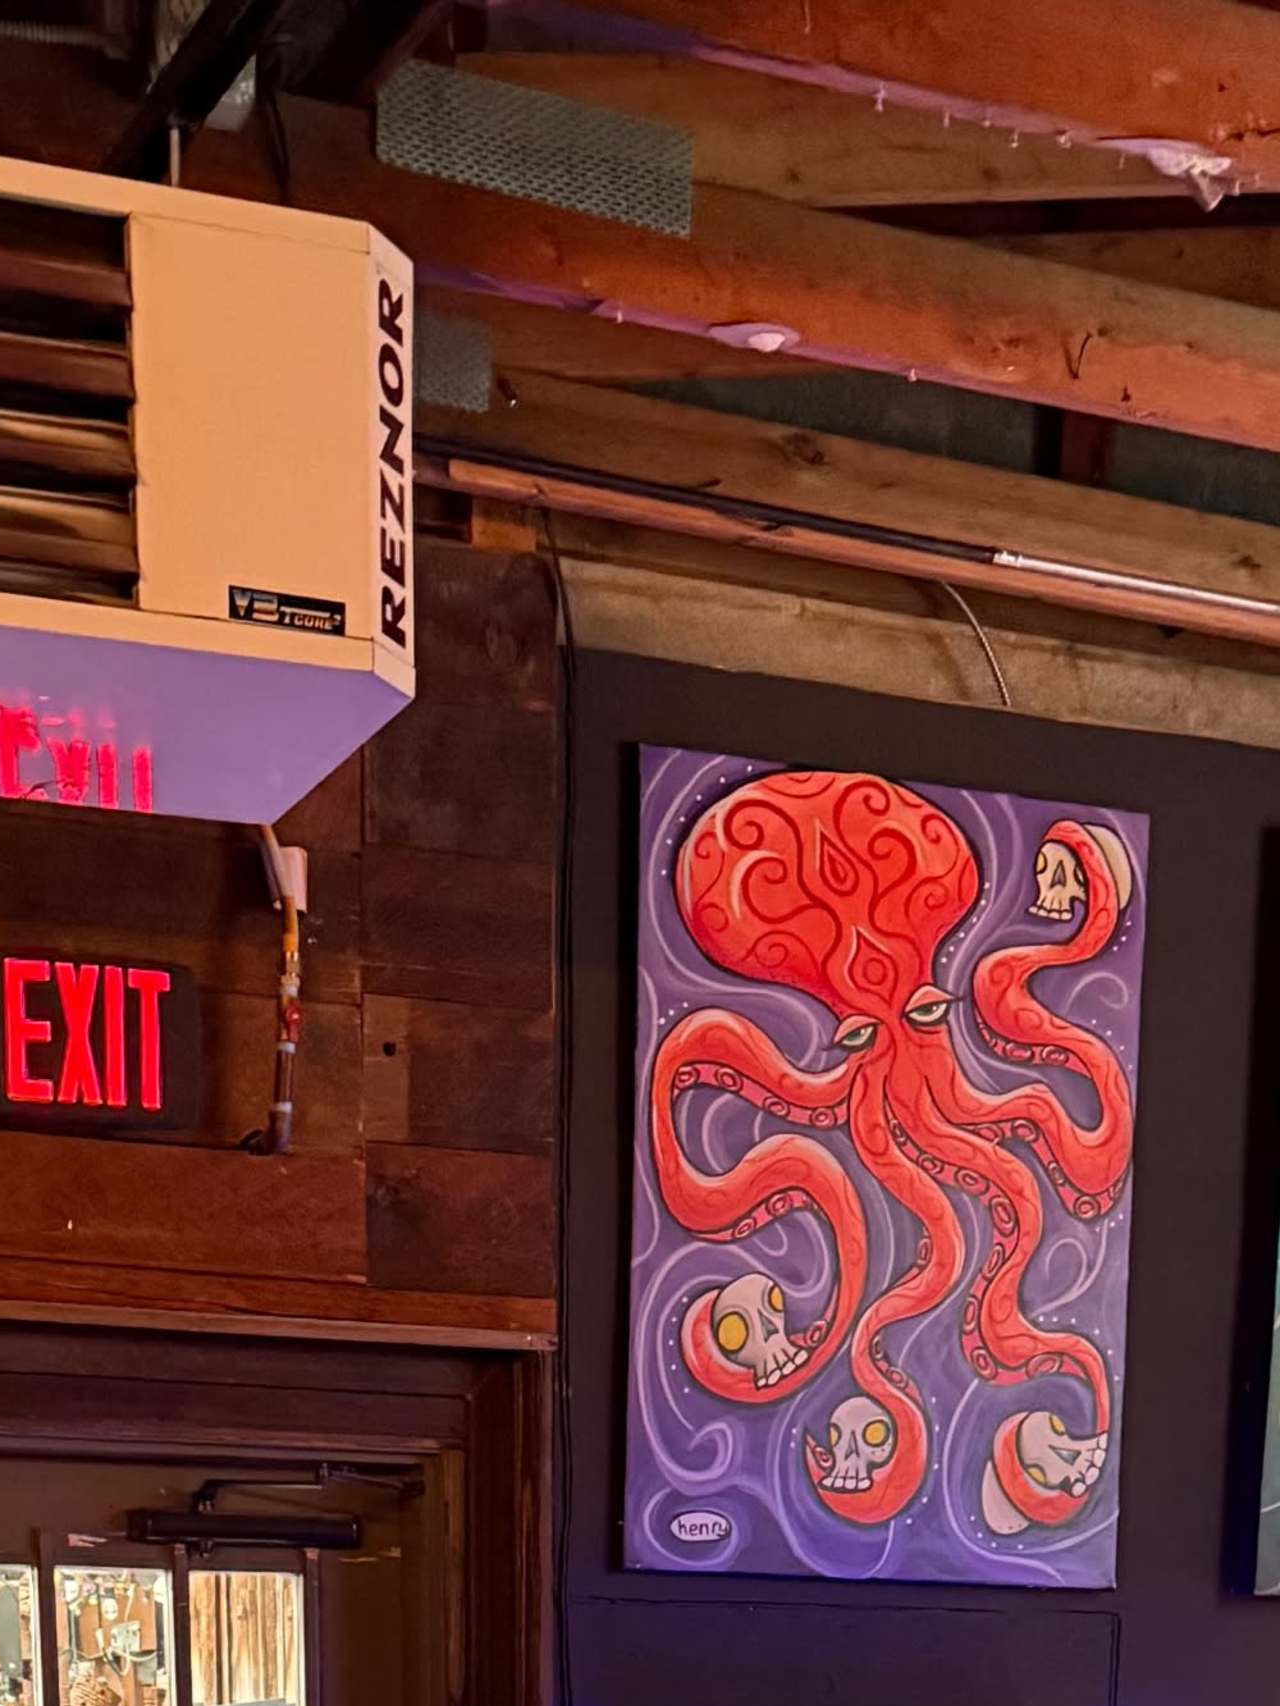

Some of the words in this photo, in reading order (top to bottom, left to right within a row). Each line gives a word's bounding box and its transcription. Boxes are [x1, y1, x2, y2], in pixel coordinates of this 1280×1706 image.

[378, 278, 406, 650] REZNOR
[2, 956, 171, 1110] EXIT
[678, 1519, 728, 1538] henry
